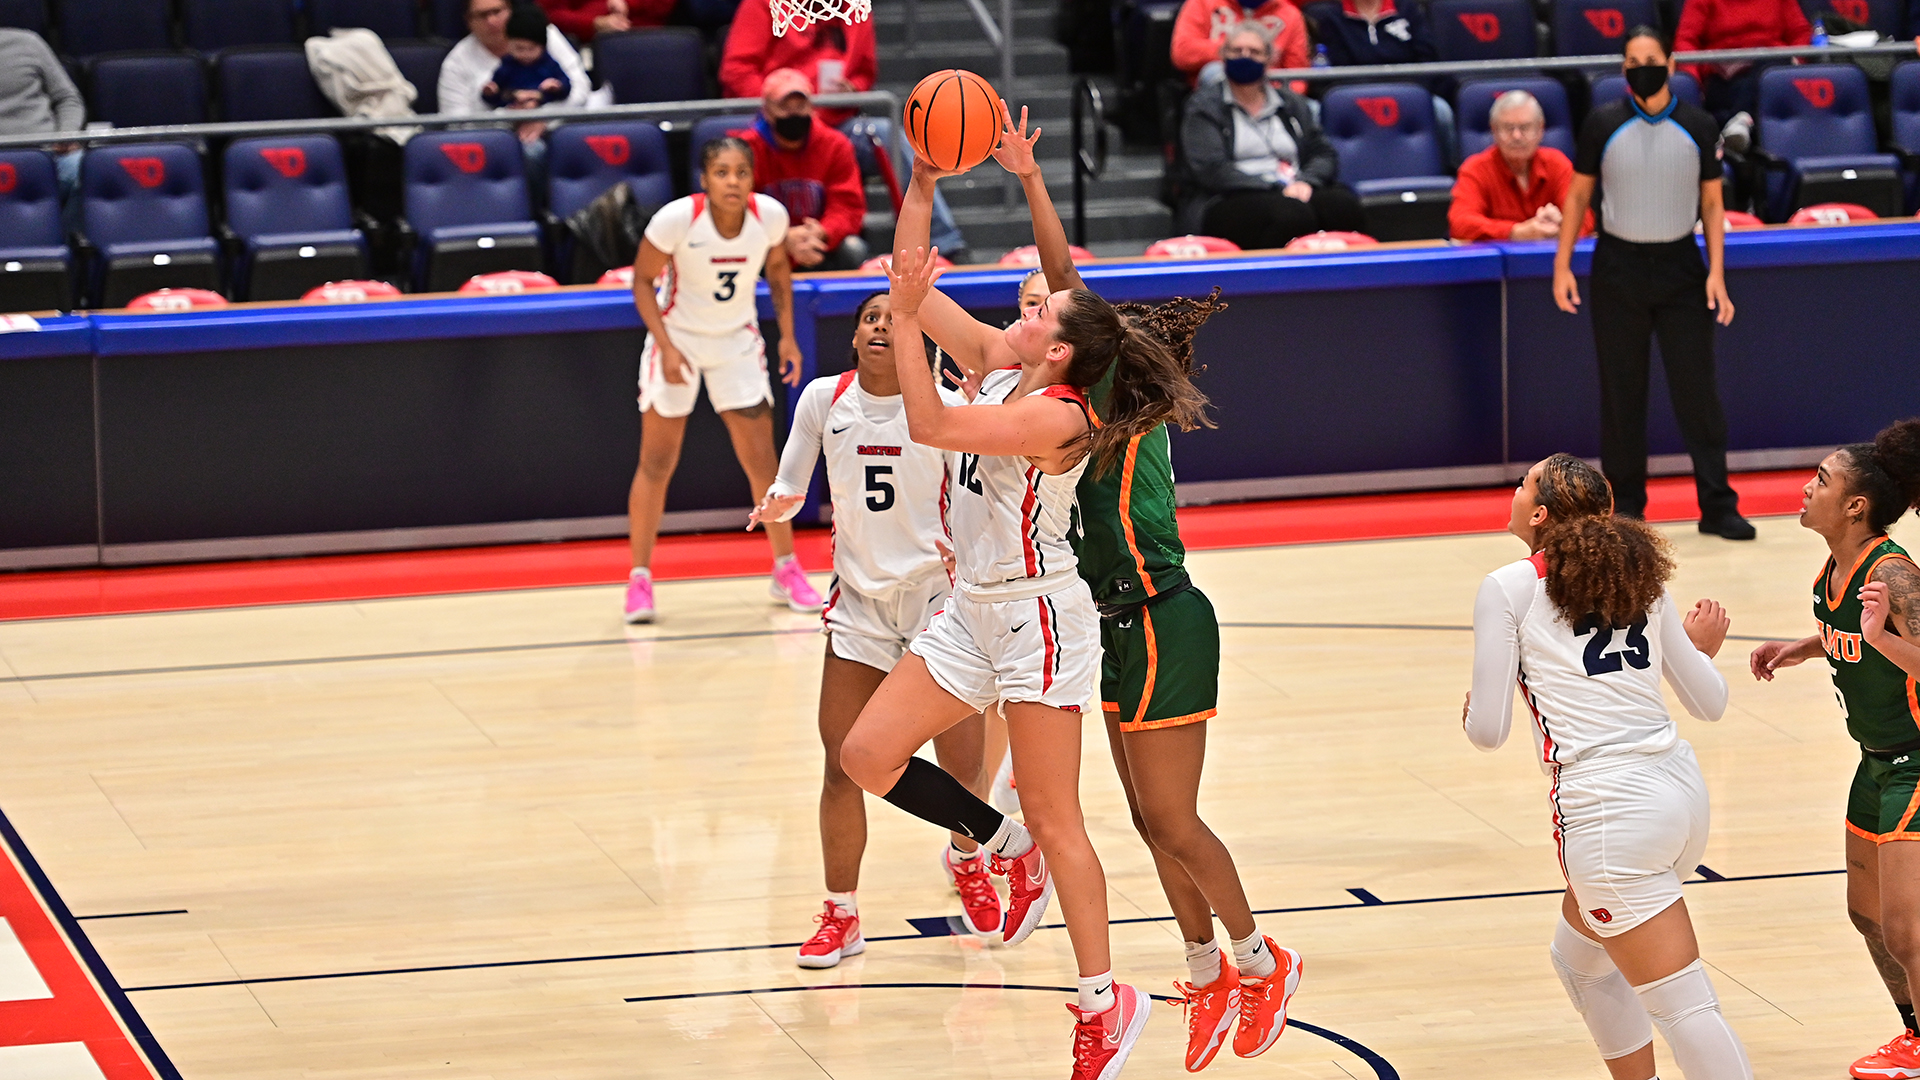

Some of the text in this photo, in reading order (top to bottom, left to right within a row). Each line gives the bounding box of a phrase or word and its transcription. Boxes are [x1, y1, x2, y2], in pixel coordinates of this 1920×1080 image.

[713, 271, 739, 302] 3
[857, 445, 902, 456] DAYTON
[864, 465, 896, 512] 5
[958, 451, 983, 496] 12
[1573, 610, 1652, 677] 23
